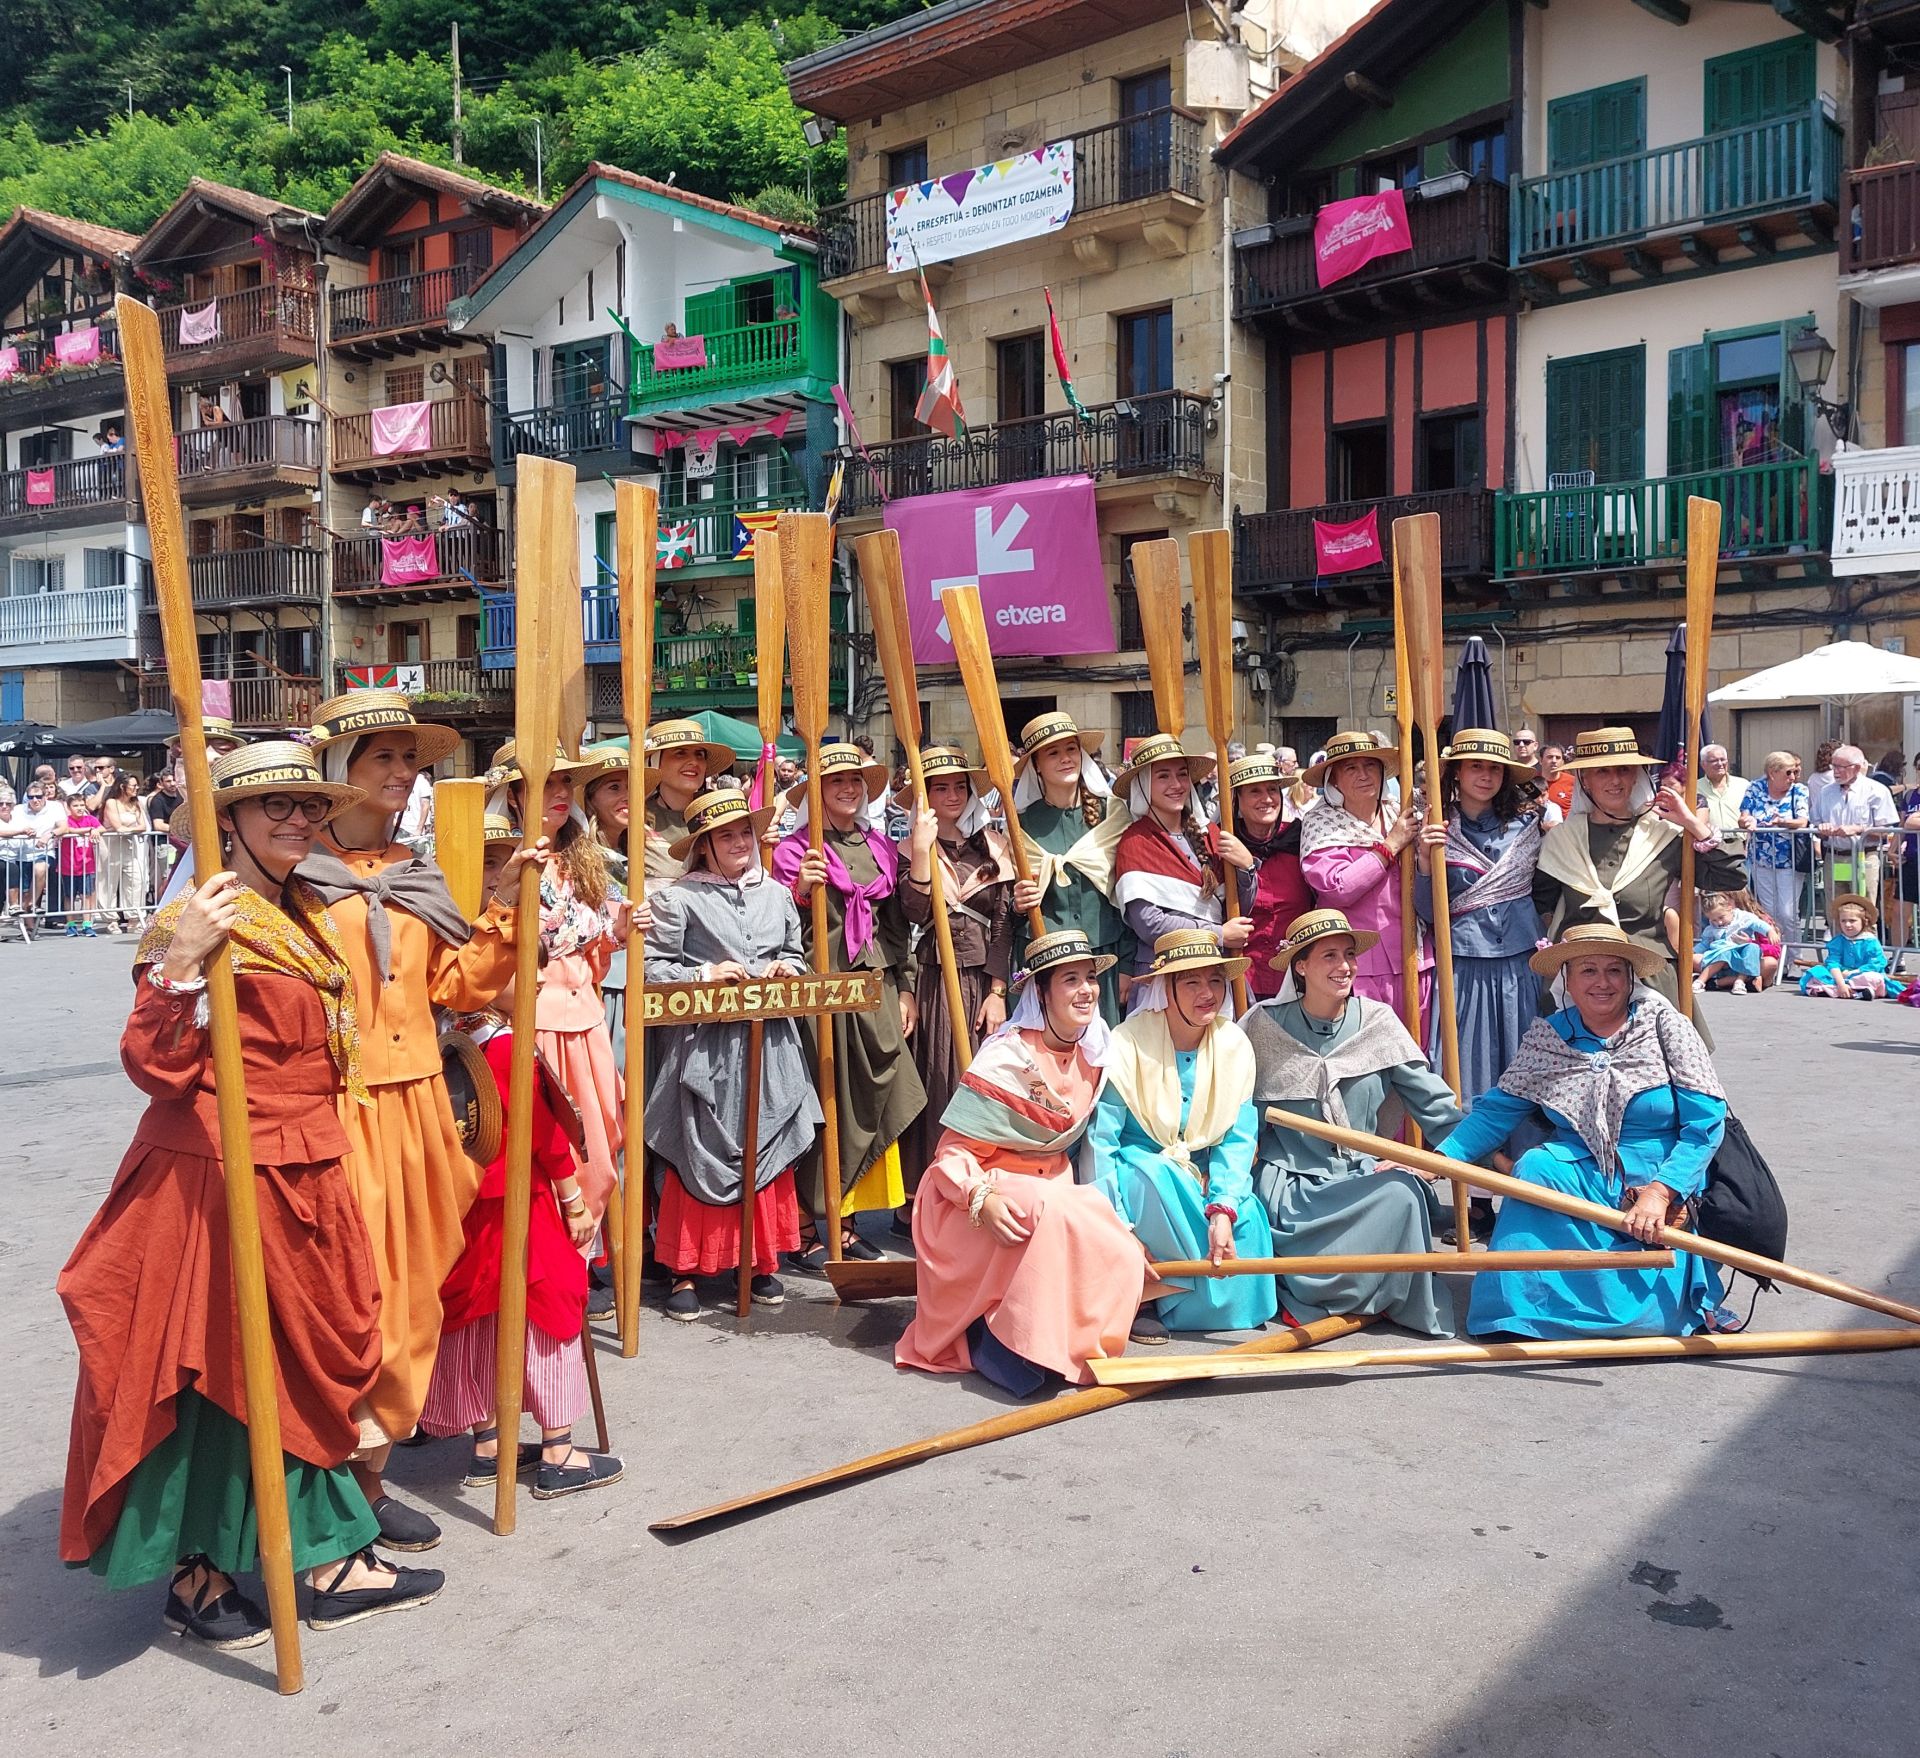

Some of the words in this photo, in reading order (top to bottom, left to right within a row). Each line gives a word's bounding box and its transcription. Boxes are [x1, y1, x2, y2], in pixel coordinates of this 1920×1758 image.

[895, 225, 909, 239] JAIA
[917, 211, 964, 232] ERRESPETUA
[972, 195, 1017, 218] DENONTZAT
[1020, 183, 1064, 205] GOZAMENA
[926, 232, 952, 248] RESPETO
[958, 222, 991, 239] DIVERSIÓN
[991, 221, 1001, 230] EN
[1002, 214, 1019, 228] TODO
[1021, 205, 1055, 221] MOMENTO
[995, 604, 1067, 627] etxera
[338, 710, 406, 733] PASAIAKO
[1030, 944, 1071, 969] PASAIAKO
[1169, 945, 1213, 959] PASAIAKO
